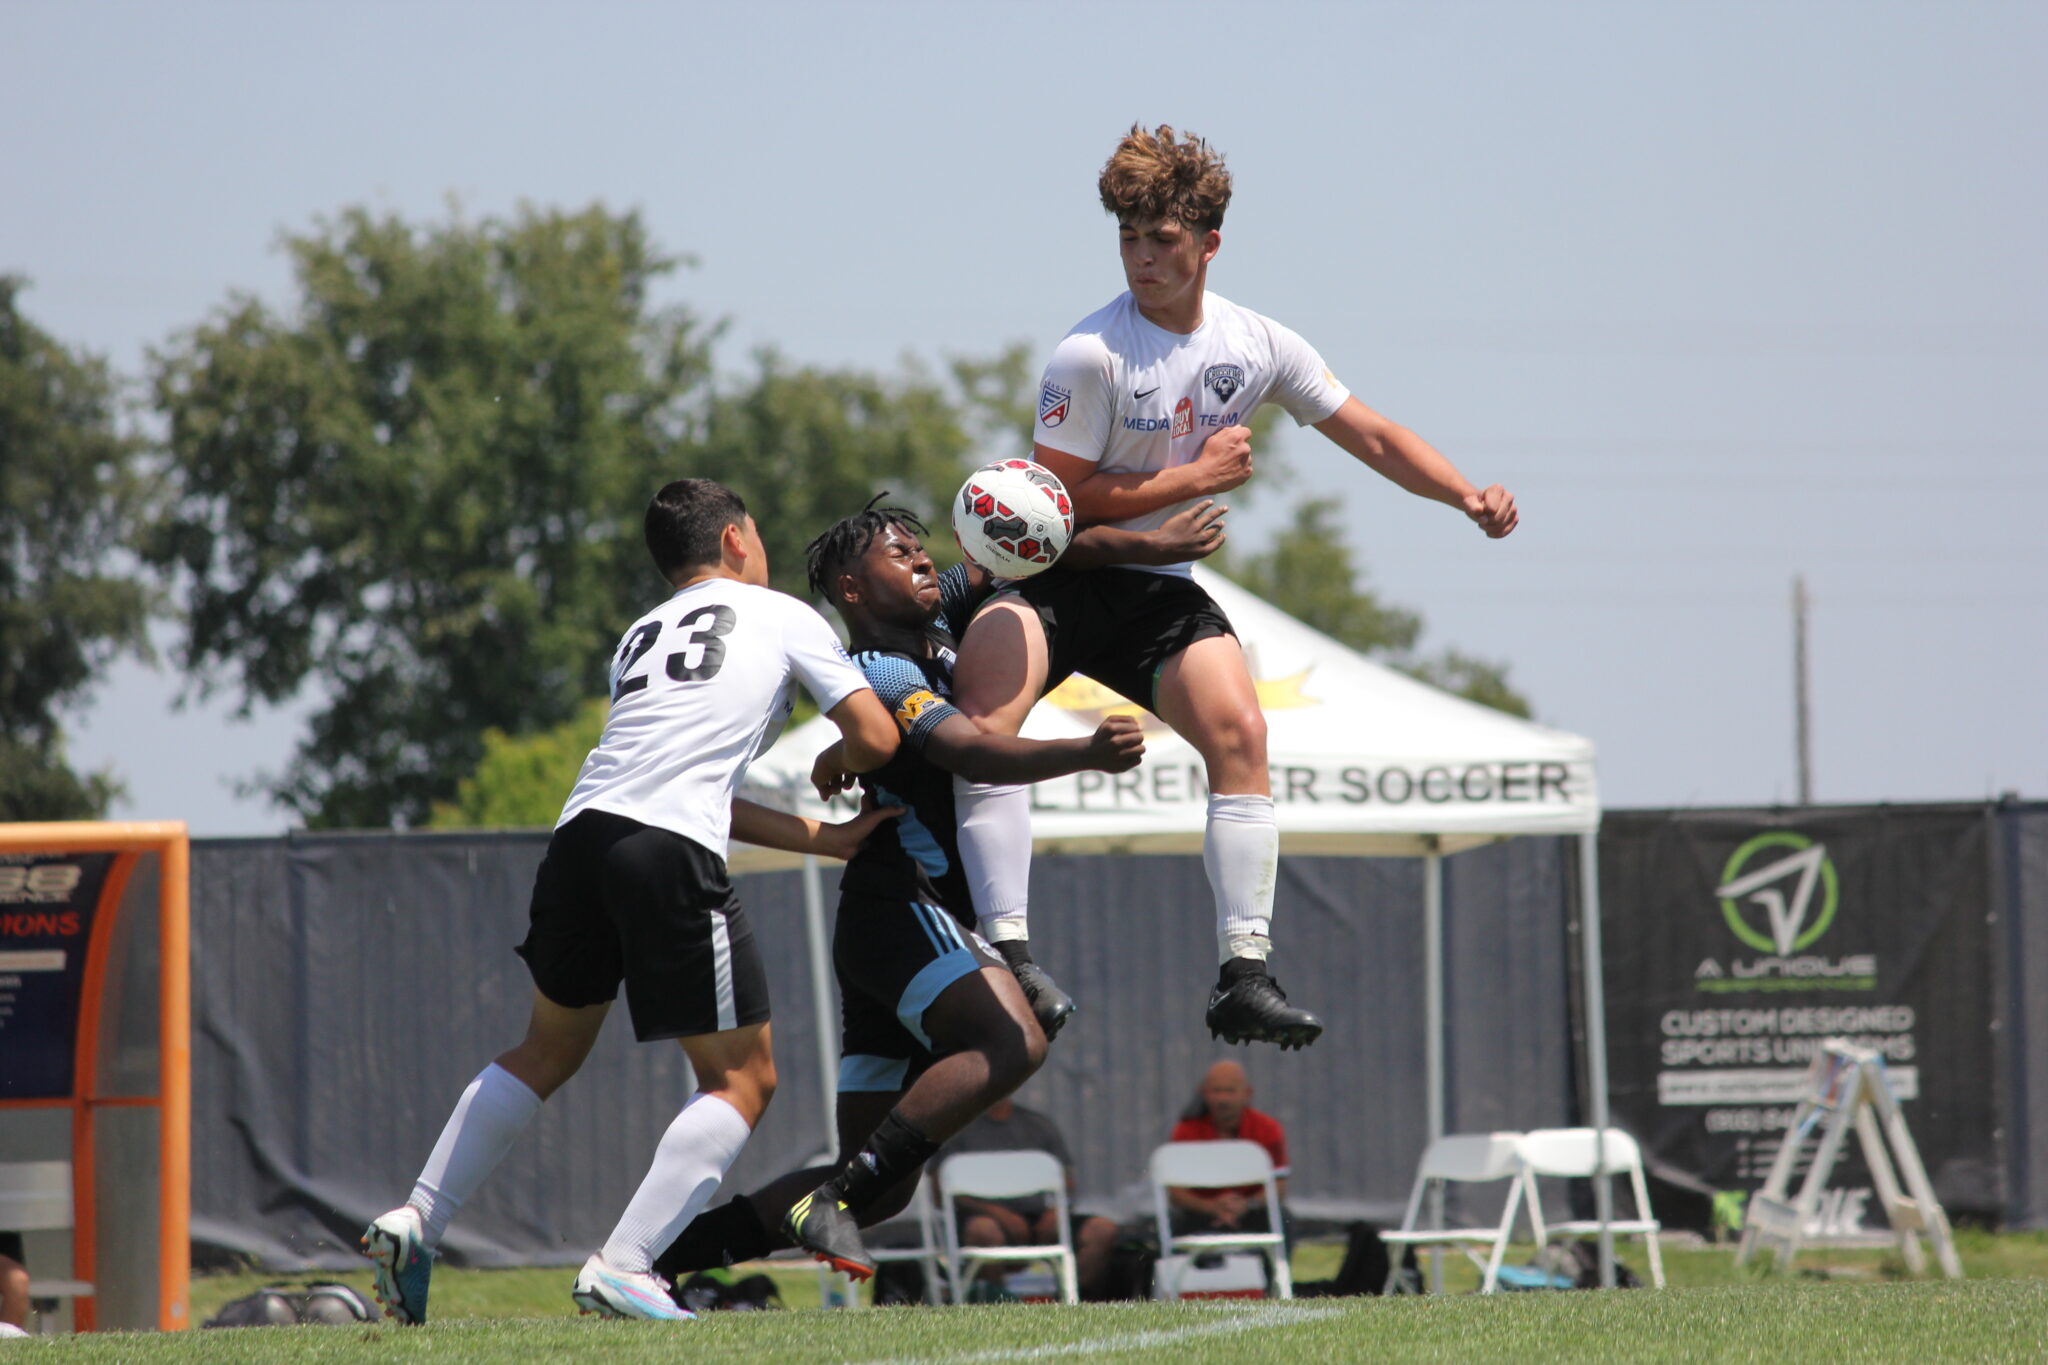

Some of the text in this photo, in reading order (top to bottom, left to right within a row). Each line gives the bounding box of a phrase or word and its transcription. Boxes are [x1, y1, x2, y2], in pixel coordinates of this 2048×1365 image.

[1123, 416, 1170, 432] MEDIA
[1175, 407, 1191, 426] BUY
[1199, 412, 1239, 427] TEAM
[1173, 422, 1192, 437] LOCAL
[612, 603, 737, 702] 23
[1077, 766, 1319, 808] PREMR
[1340, 761, 1572, 804] SOCCER
[0, 911, 81, 936] IONS
[1695, 957, 1724, 978] A
[1660, 1005, 1916, 1036] CUSTOM DESIGNED
[1660, 1033, 1916, 1065] SPORTS UNIMS
